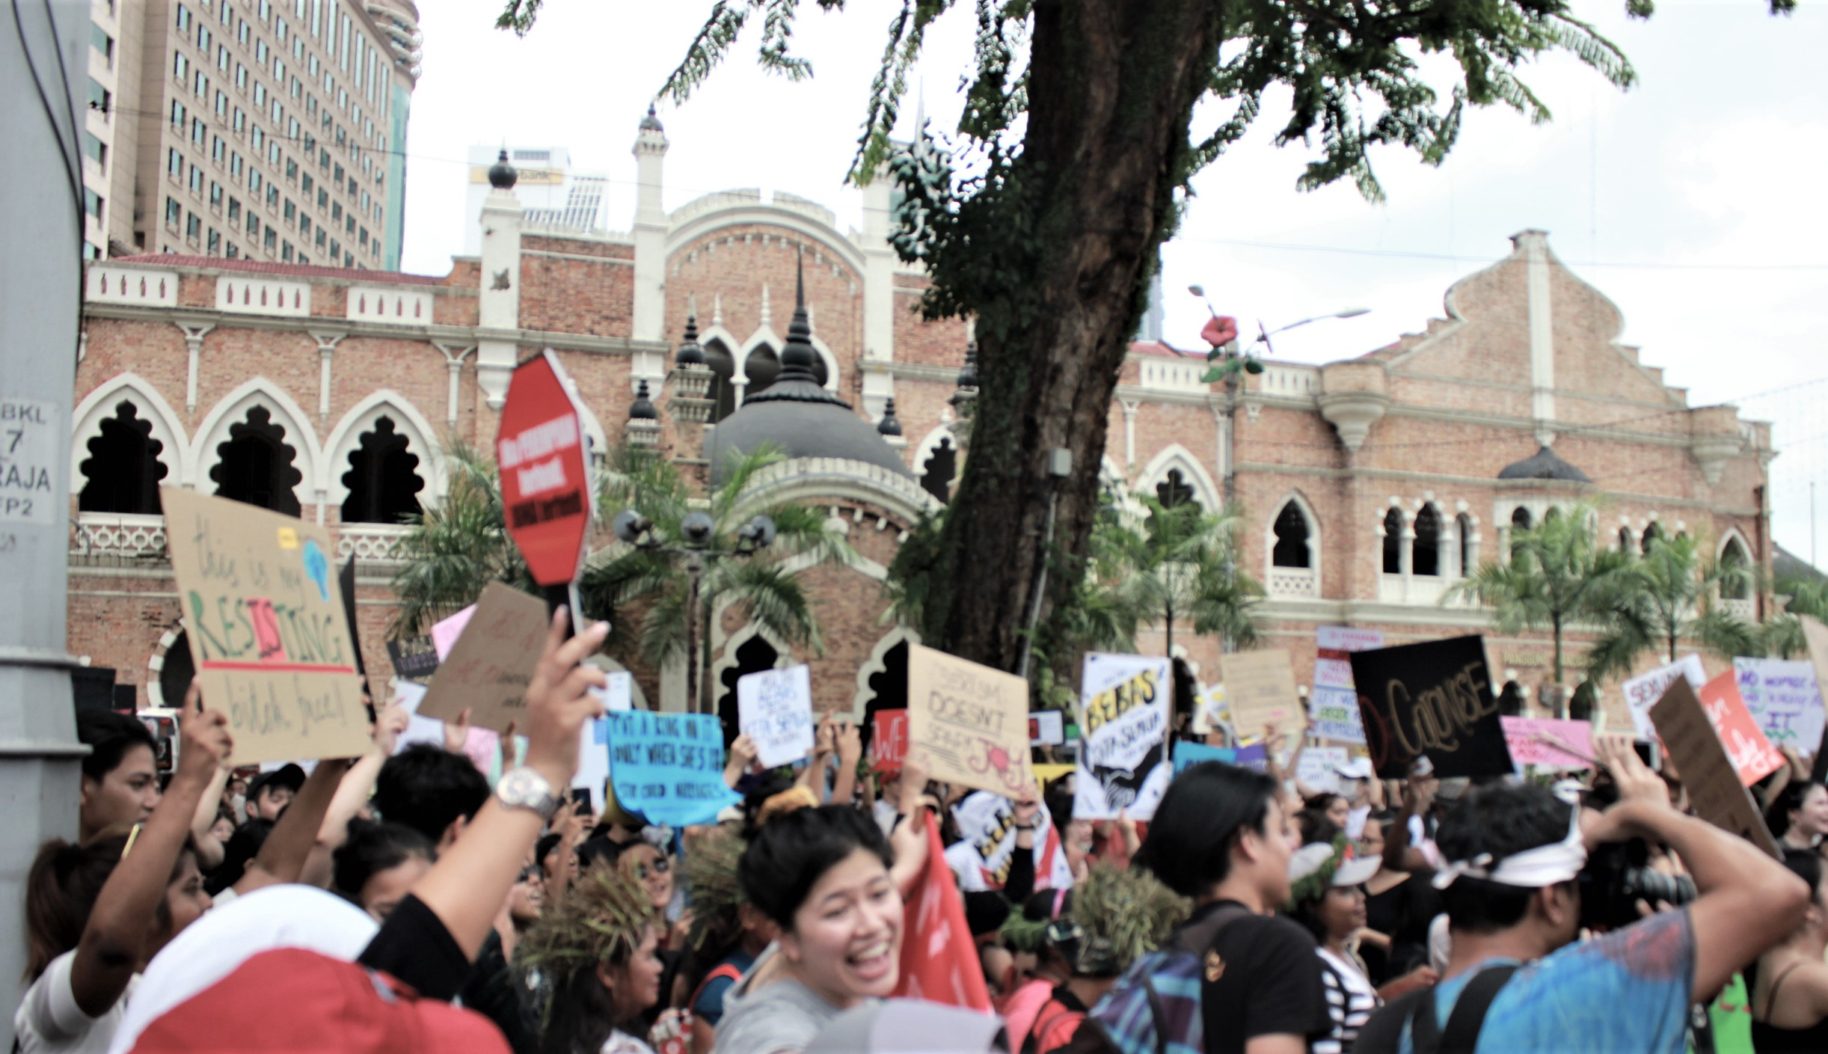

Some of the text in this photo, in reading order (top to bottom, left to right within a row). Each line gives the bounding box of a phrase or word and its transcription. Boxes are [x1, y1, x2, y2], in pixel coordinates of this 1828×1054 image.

[6, 429, 24, 453] 7
[0, 464, 51, 491] AJA
[0, 497, 33, 516] P2
[1085, 668, 1157, 738] BEBAS
